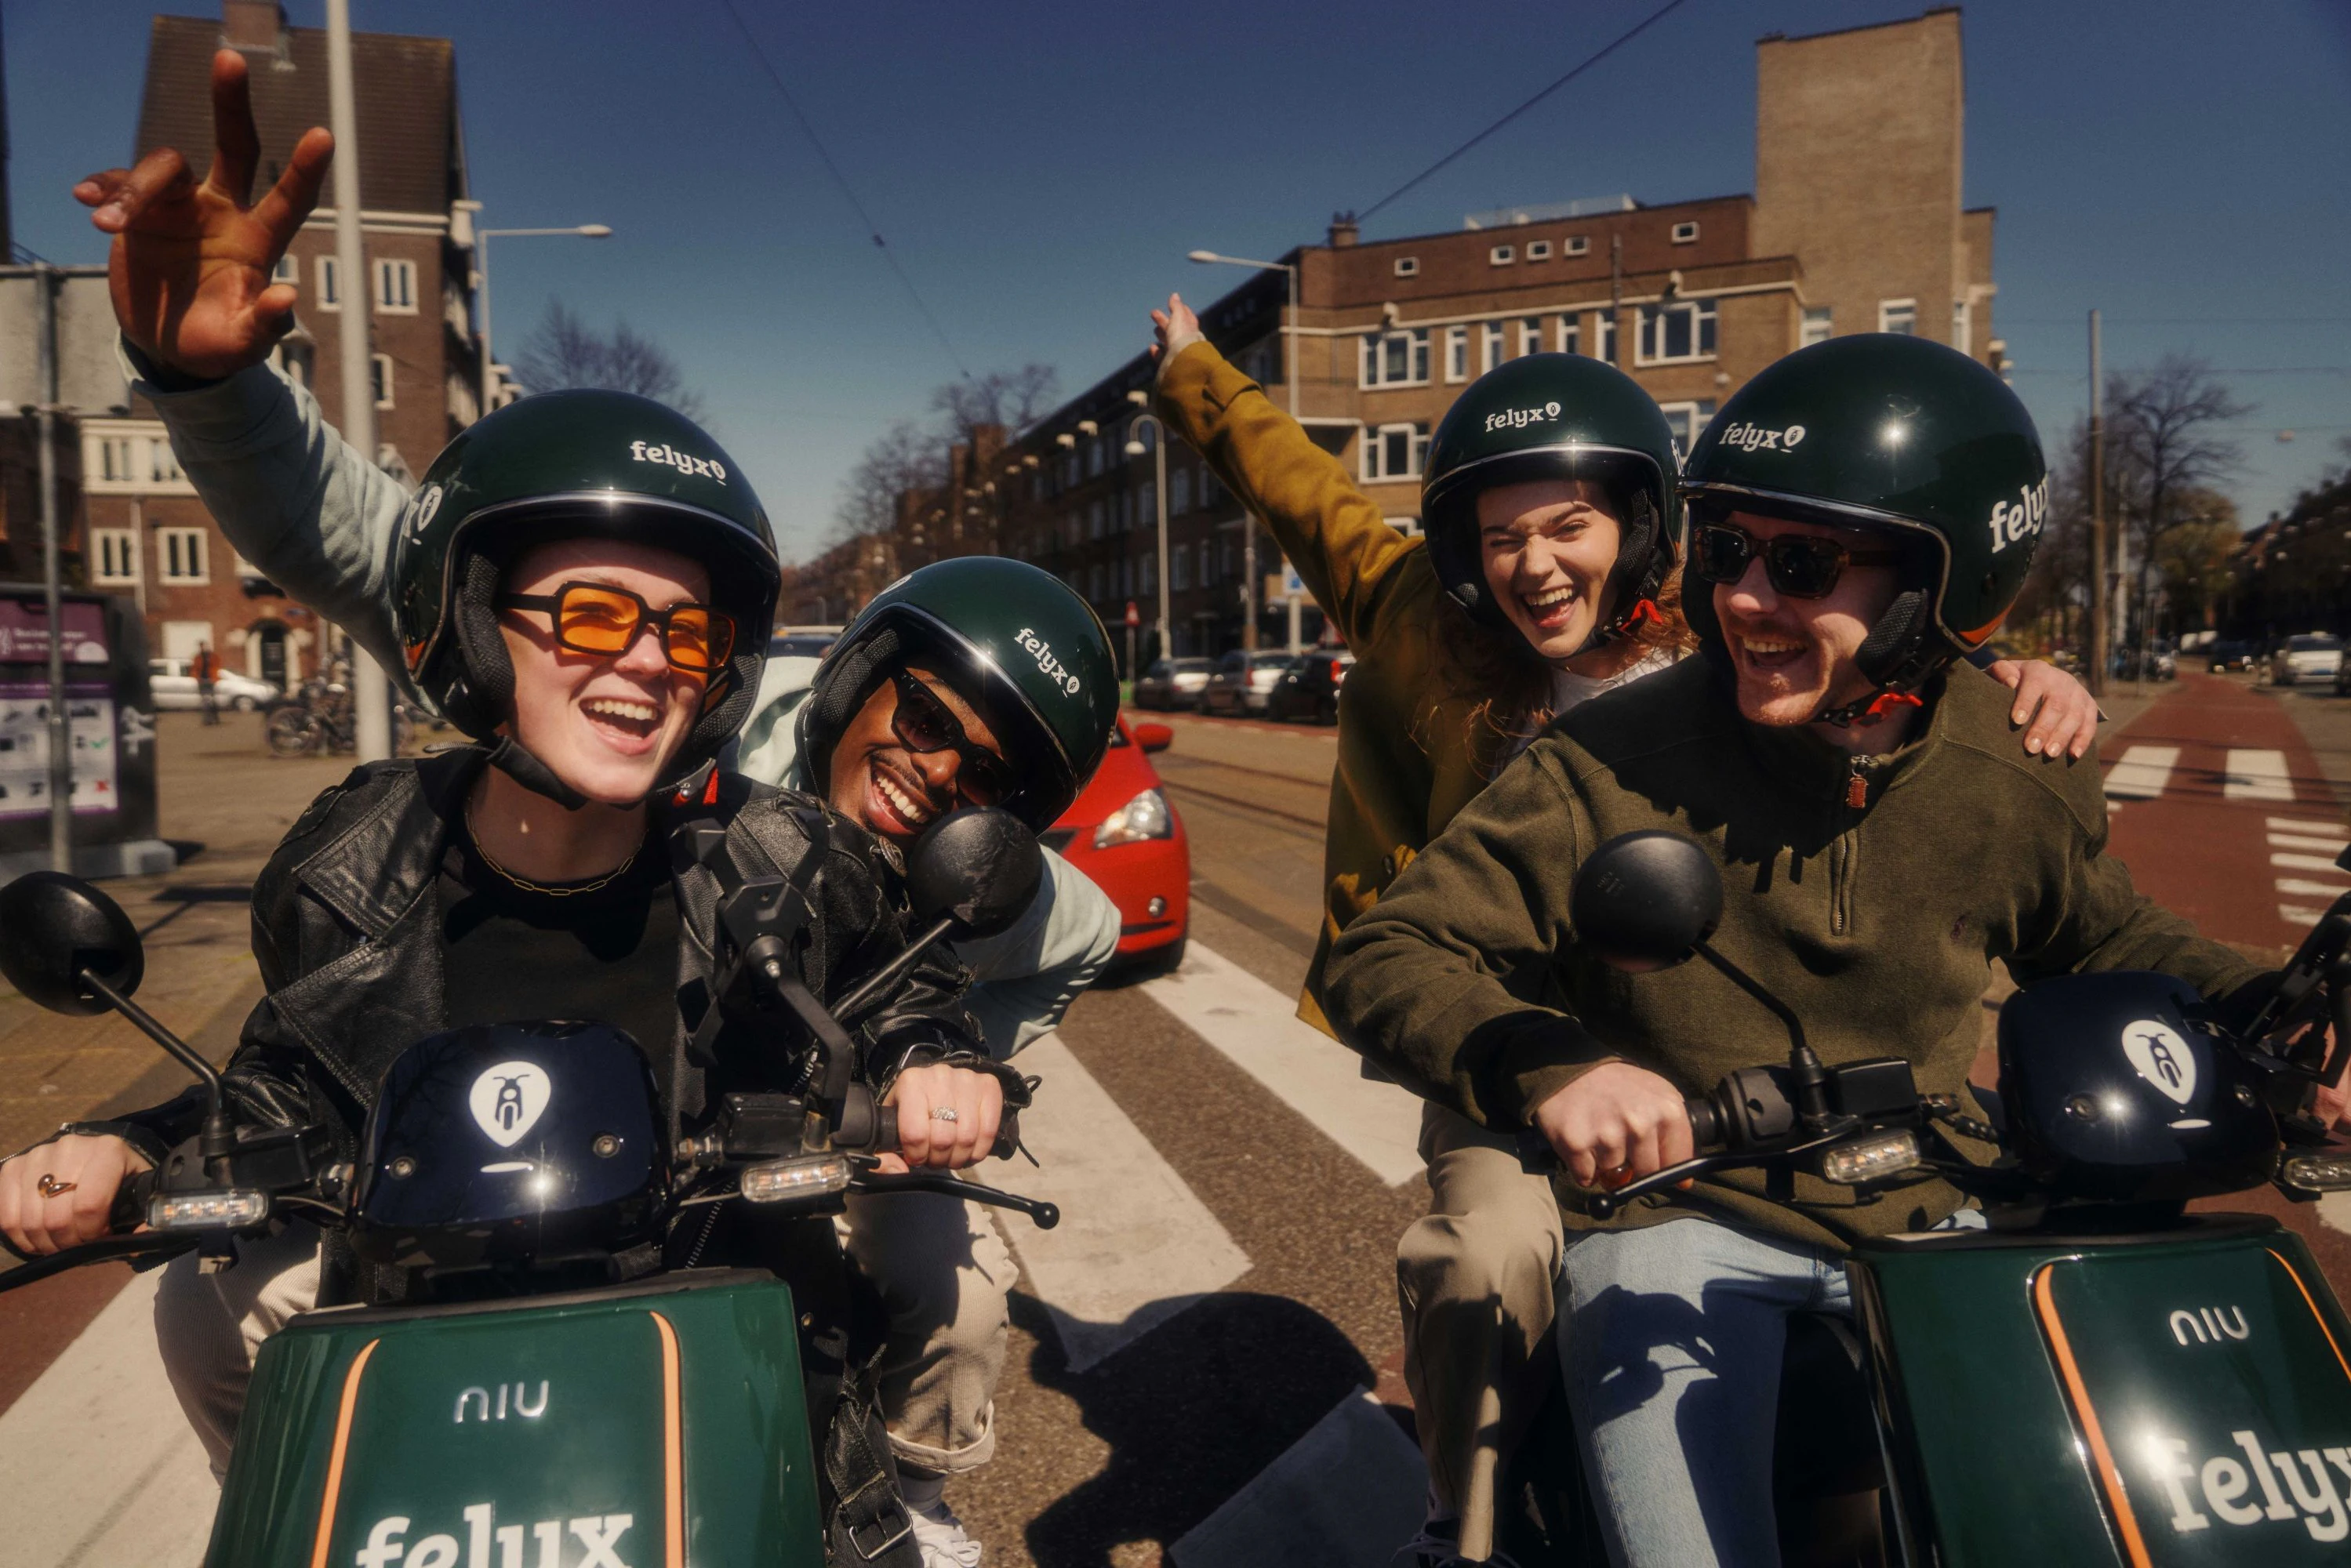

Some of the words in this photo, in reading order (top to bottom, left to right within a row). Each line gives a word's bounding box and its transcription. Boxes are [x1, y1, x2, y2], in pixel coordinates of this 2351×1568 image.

[1484, 408, 1543, 432] felyx
[1719, 422, 1783, 452] felyx
[629, 440, 712, 478] felyx
[1014, 628, 1068, 686] felyx
